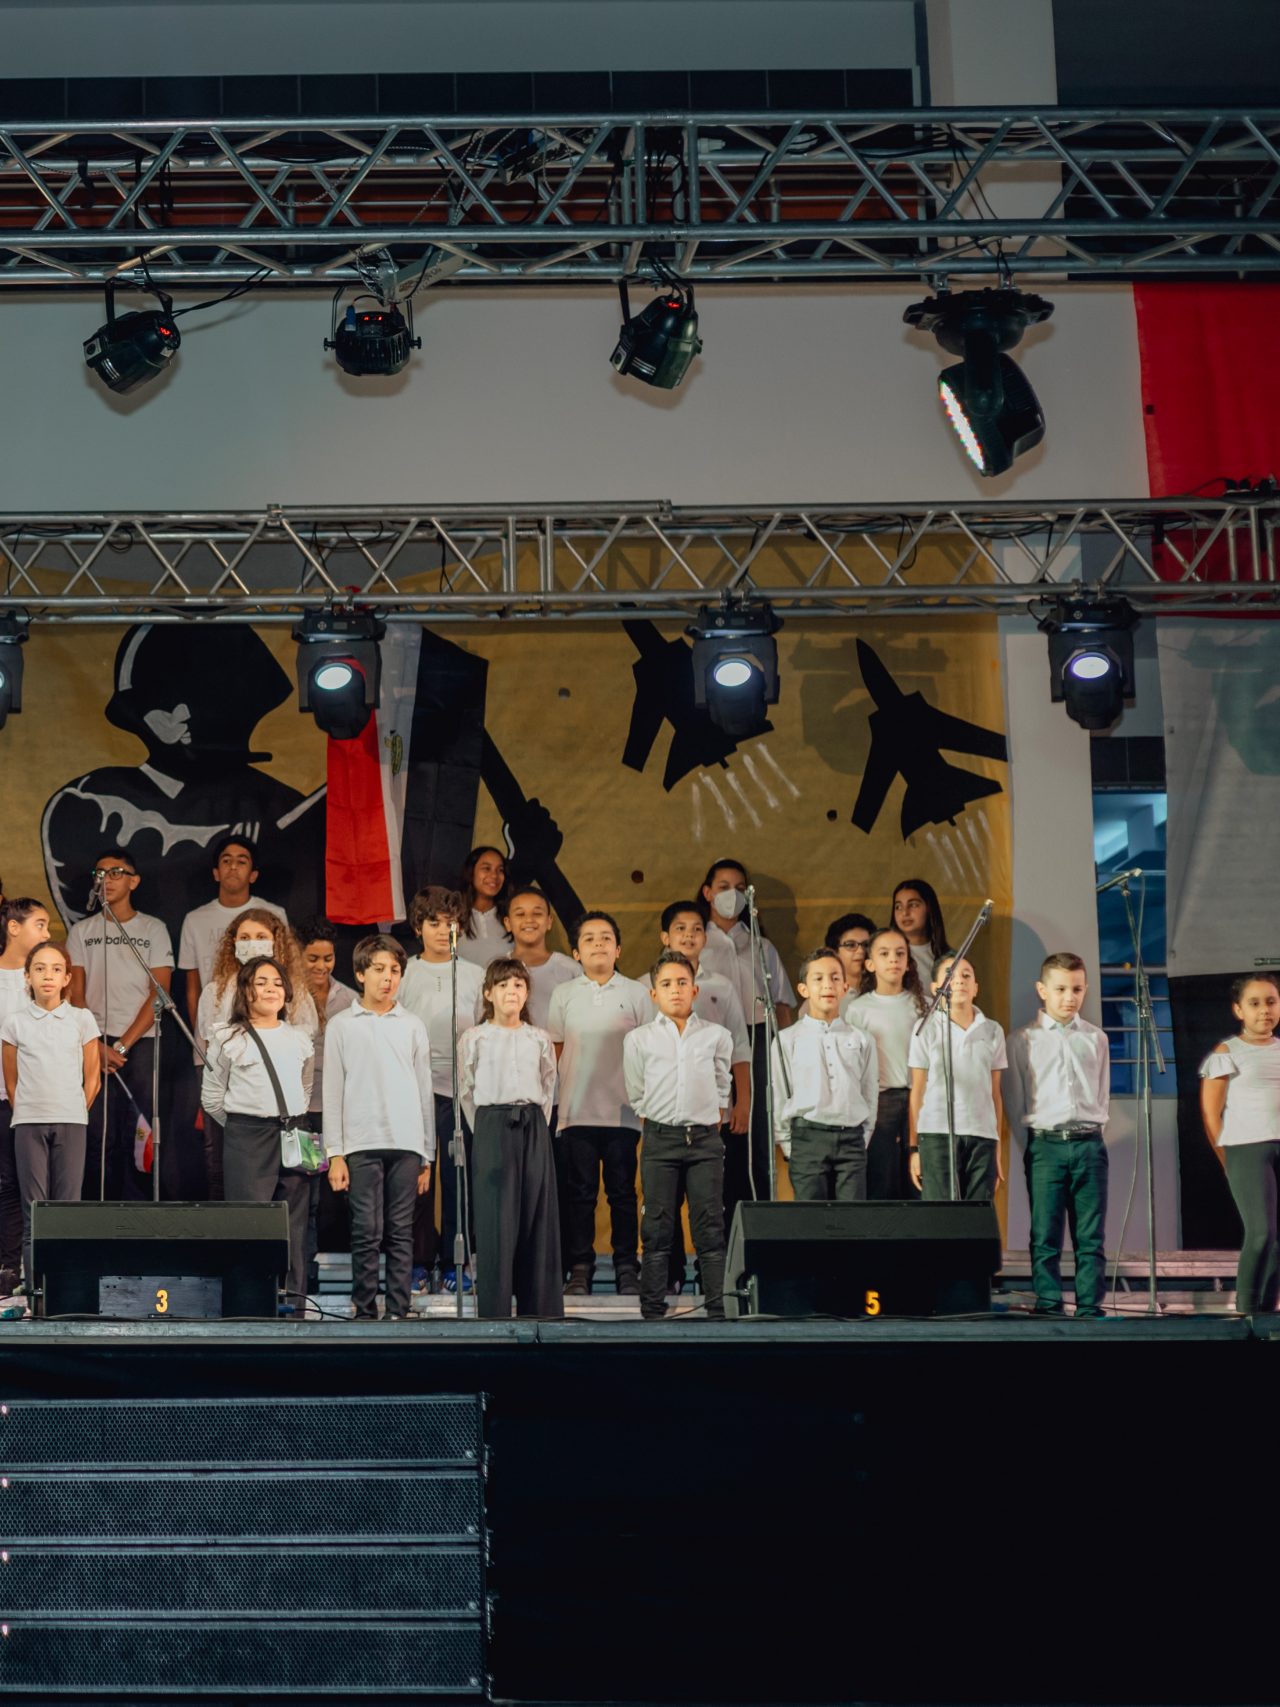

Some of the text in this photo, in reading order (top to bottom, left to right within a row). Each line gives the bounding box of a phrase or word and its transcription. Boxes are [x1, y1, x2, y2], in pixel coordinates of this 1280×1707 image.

[105, 935, 151, 949] balance
[155, 1289, 168, 1313] 3
[865, 1290, 881, 1316] 5
